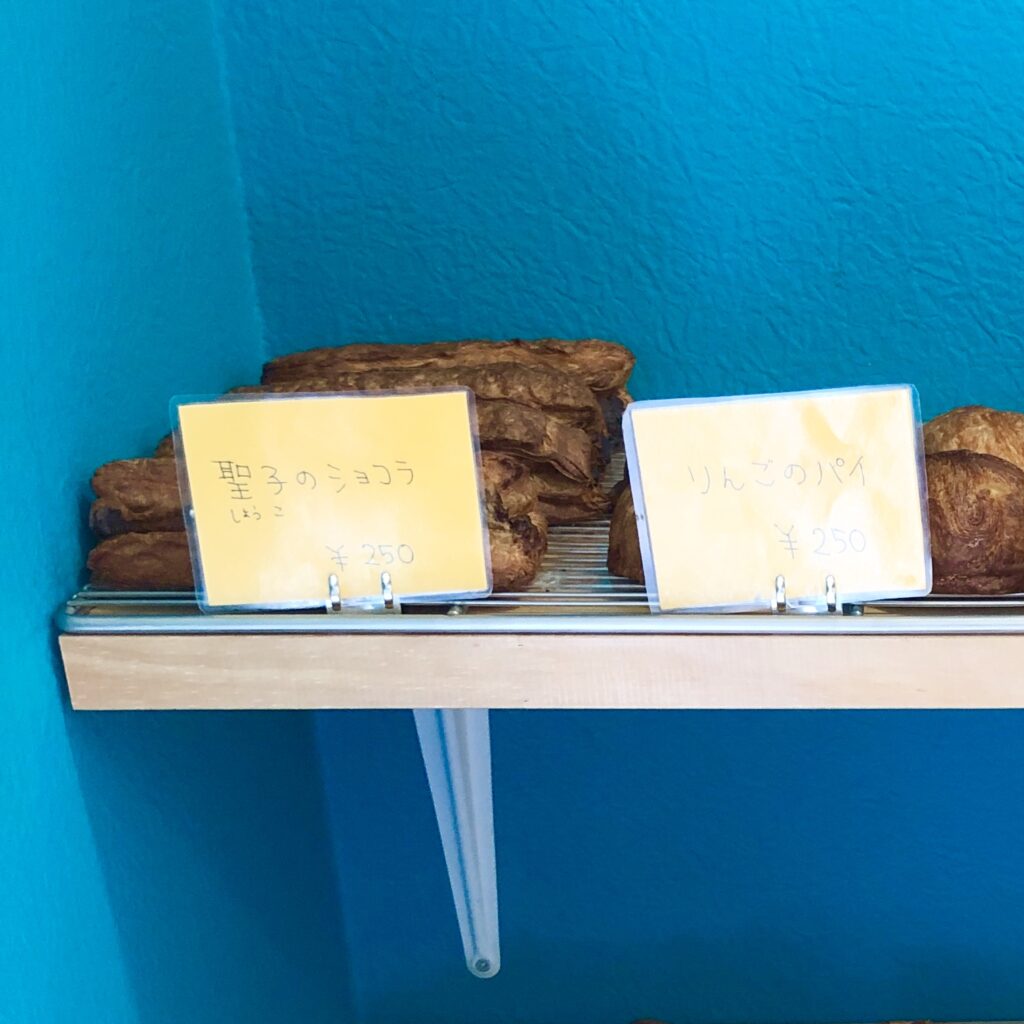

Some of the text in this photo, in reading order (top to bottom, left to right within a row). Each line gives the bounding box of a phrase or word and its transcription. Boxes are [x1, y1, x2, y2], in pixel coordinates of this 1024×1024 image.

[688, 456, 866, 495] りんごのパイ
